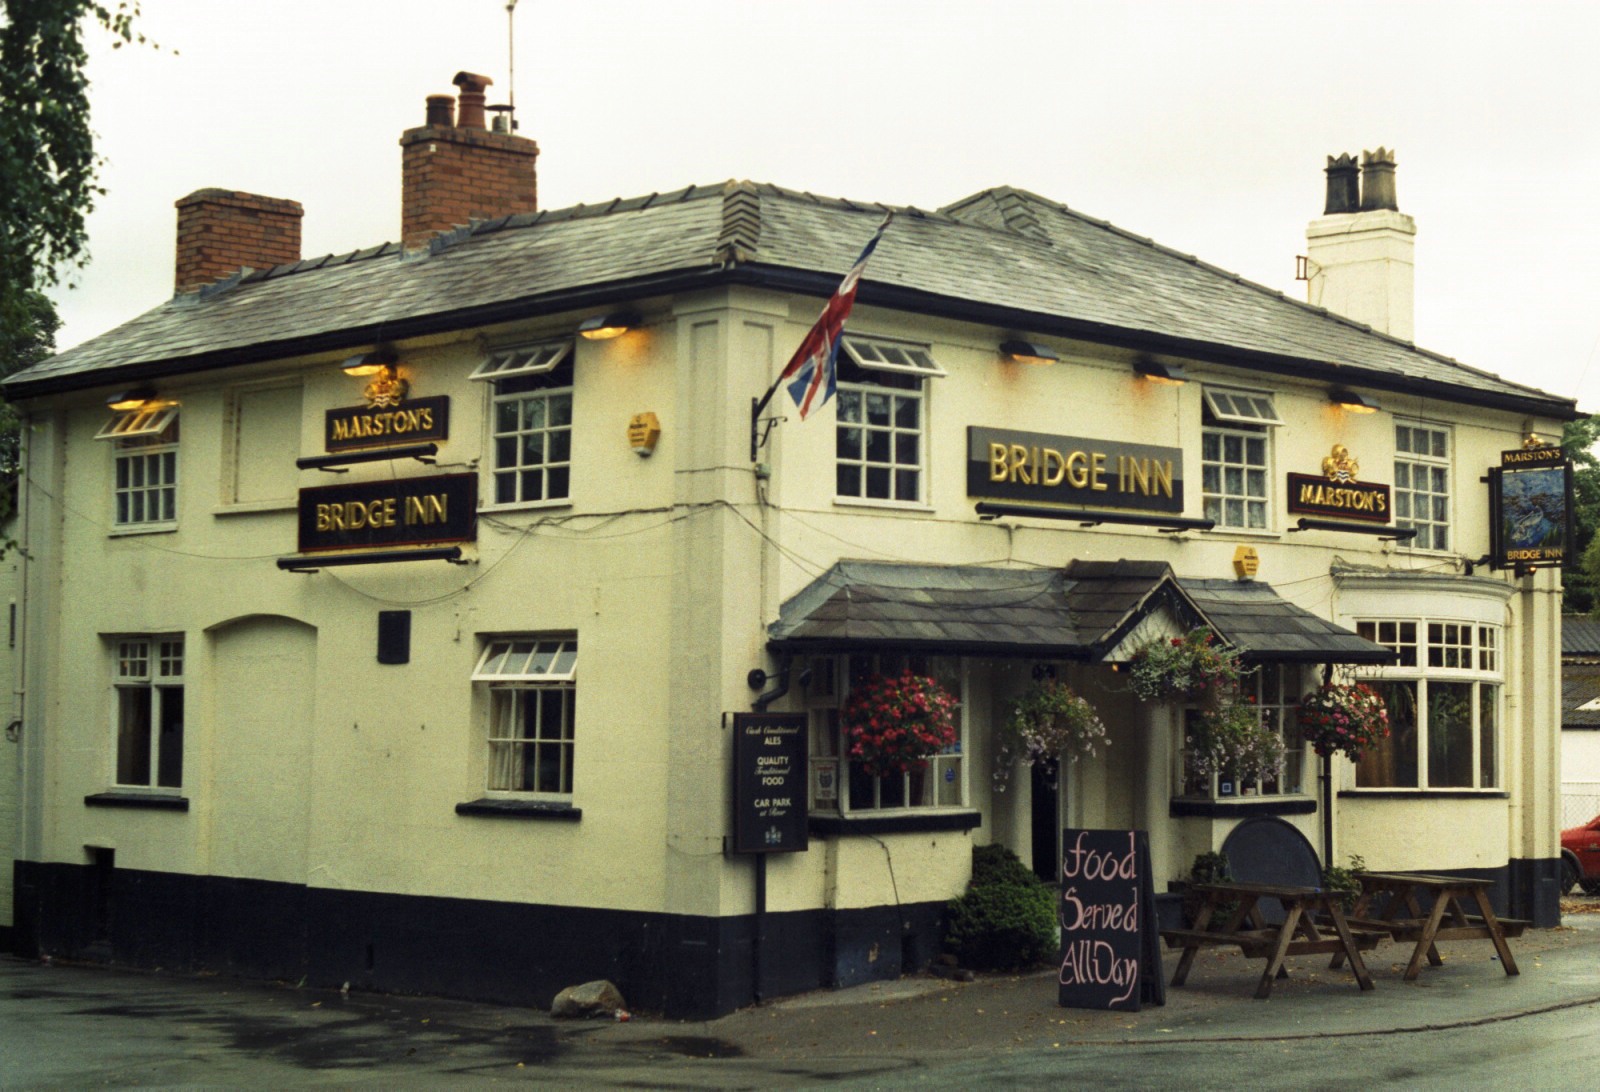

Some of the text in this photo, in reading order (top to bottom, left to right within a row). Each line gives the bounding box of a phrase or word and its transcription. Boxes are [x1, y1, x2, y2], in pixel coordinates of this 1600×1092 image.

[331, 407, 433, 440] MARSTON'S
[1504, 449, 1561, 463] MARSTON'S
[989, 442, 1173, 498] BRIDGE INN
[1300, 483, 1386, 512] MARSTON'S
[316, 493, 448, 531] BRIDGE INN
[1507, 548, 1563, 560] BRIDGE INN
[763, 736, 782, 745] ALES
[757, 756, 789, 765] QUALITY
[762, 777, 785, 786] FOOD
[754, 798, 792, 808] CAR PARK
[1061, 886, 1138, 933] Served
